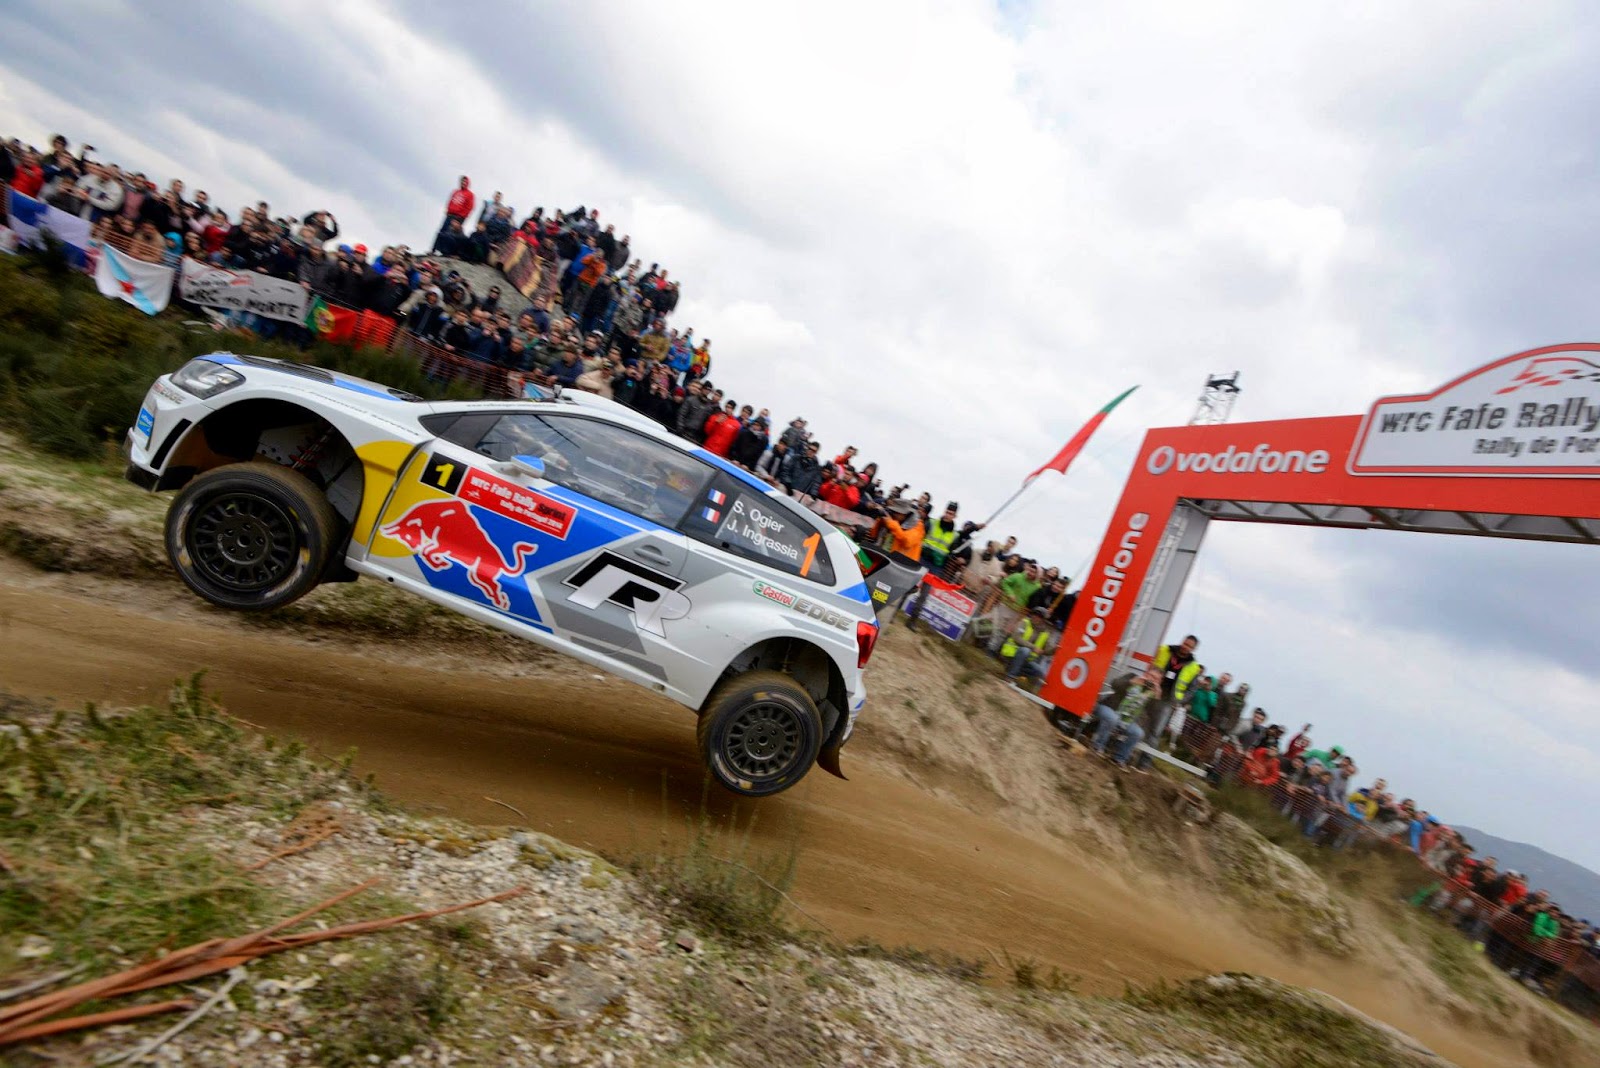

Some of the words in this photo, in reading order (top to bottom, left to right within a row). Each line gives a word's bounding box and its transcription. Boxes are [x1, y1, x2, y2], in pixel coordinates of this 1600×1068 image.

[1437, 403, 1508, 431] Fafe
[1514, 396, 1600, 433] Rally
[1175, 443, 1329, 474] vodafone
[1472, 437, 1525, 458] Rally
[1529, 436, 1557, 454] de
[435, 463, 455, 487] 1
[490, 483, 513, 499] Fafe
[512, 492, 537, 511] Rally
[732, 500, 746, 516] S.
[749, 509, 785, 533] Ogier
[726, 520, 739, 533] J.
[742, 524, 798, 560] Ingrassia
[800, 532, 821, 577] 1
[560, 546, 693, 639] R
[1076, 512, 1150, 655] vodafone
[763, 586, 794, 606] Castrol
[793, 598, 854, 632] EDGE
